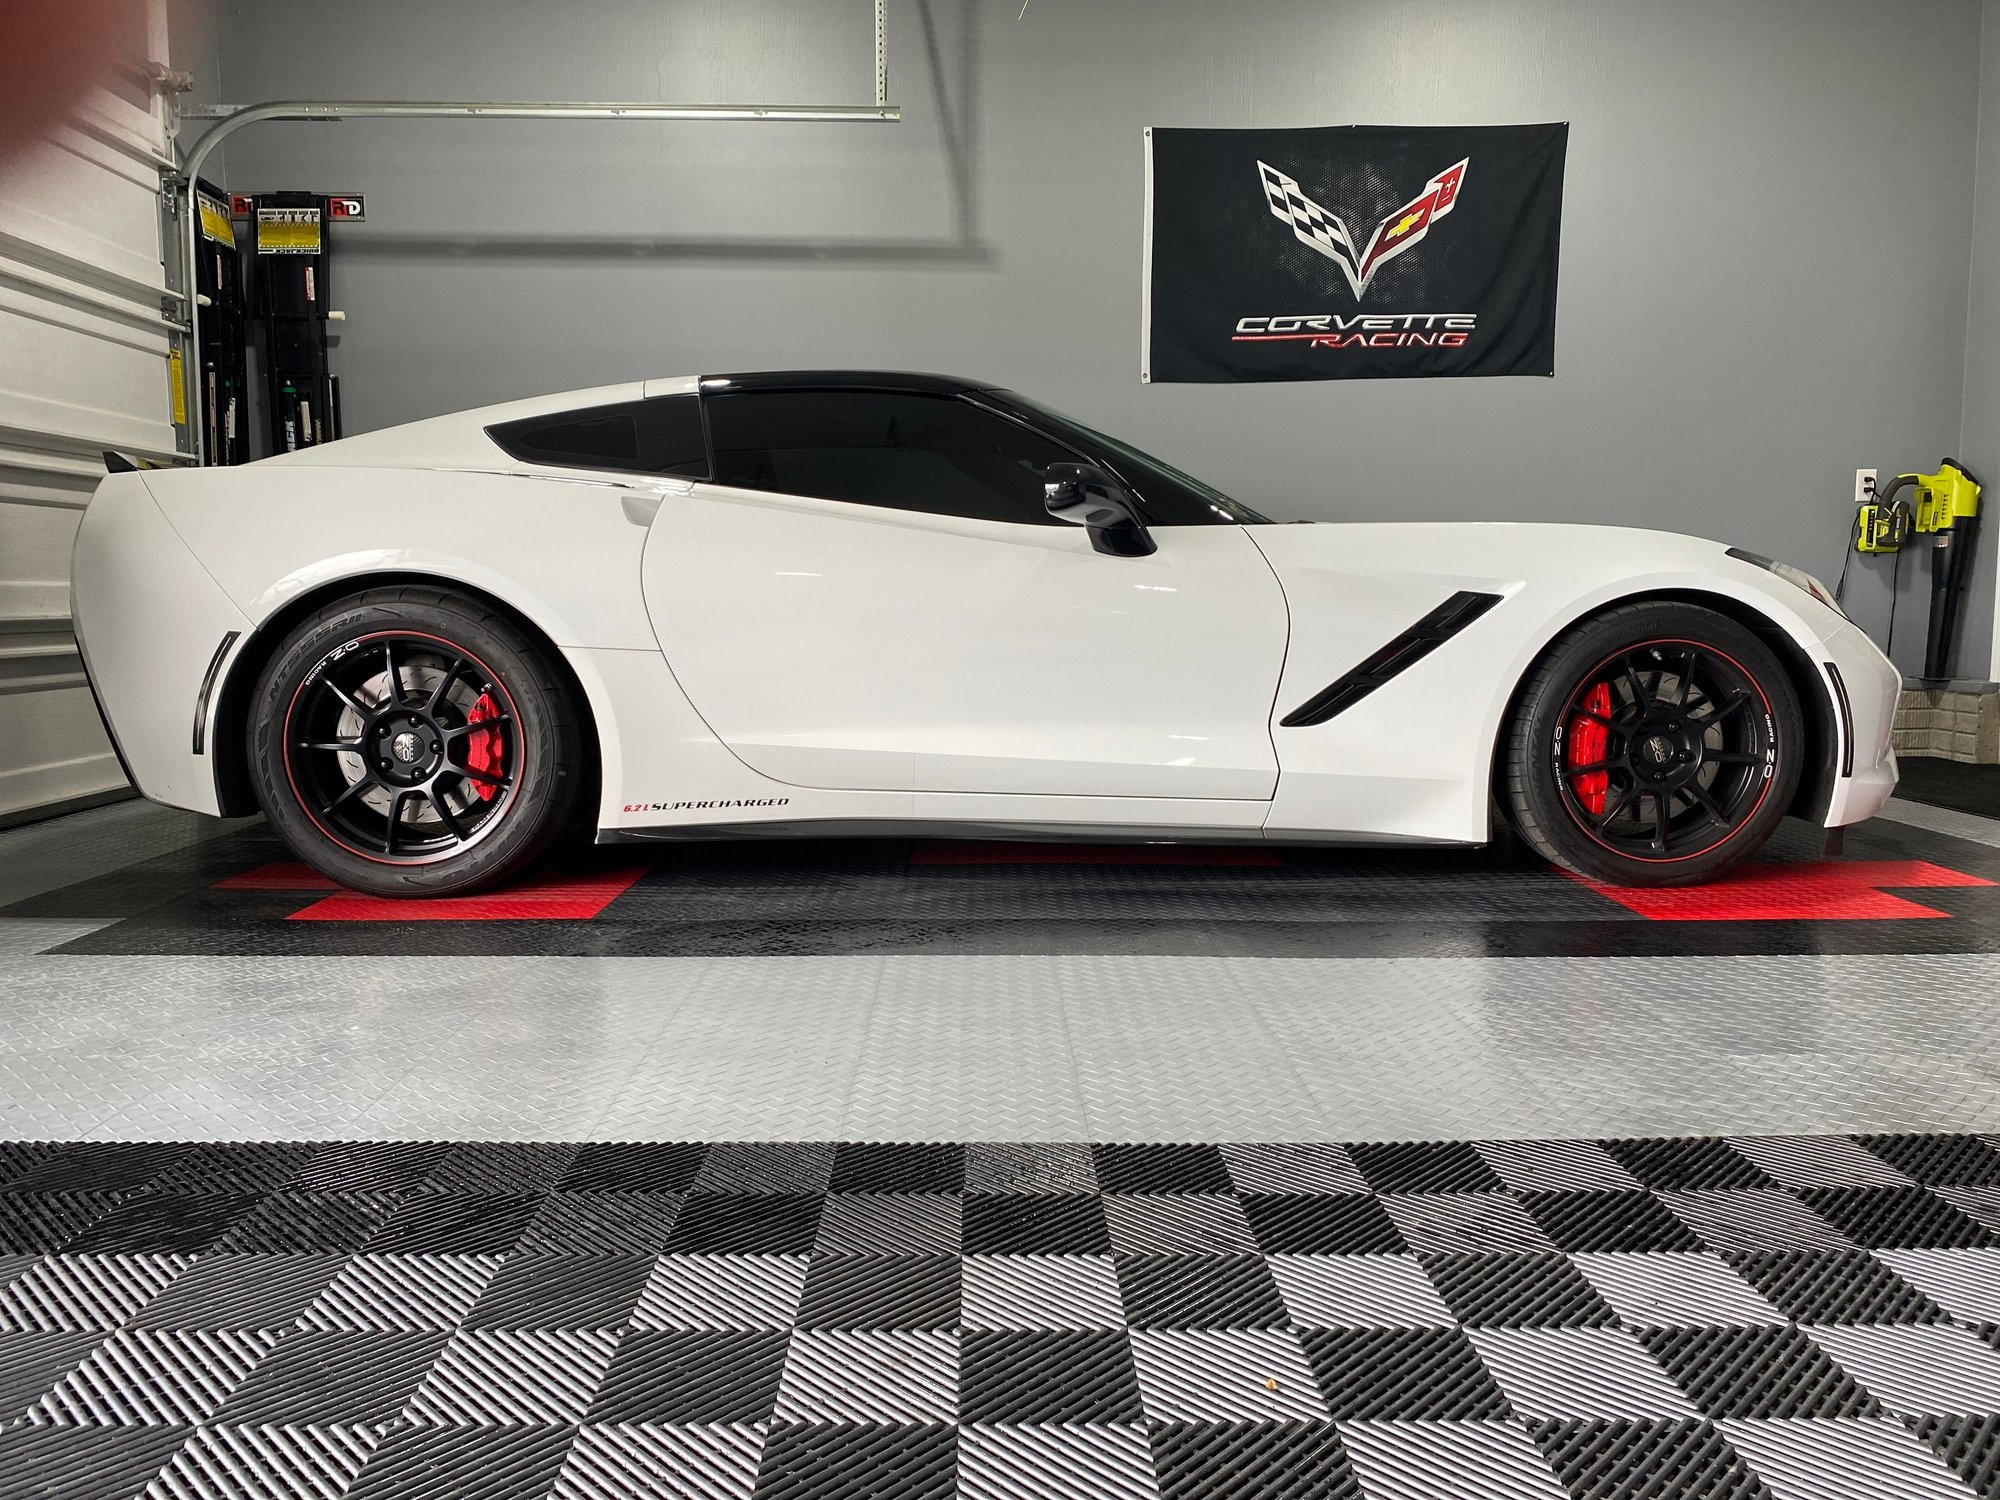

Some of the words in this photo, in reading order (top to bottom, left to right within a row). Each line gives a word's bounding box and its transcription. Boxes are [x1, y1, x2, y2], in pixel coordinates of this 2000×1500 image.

[1235, 313, 1477, 334] CORVETTE
[1309, 332, 1469, 349] RACING
[305, 660, 327, 686] RACING
[1764, 713, 1775, 743] RACING
[1554, 762, 1564, 791] RACING
[651, 798, 790, 811] SUPERCHARGED
